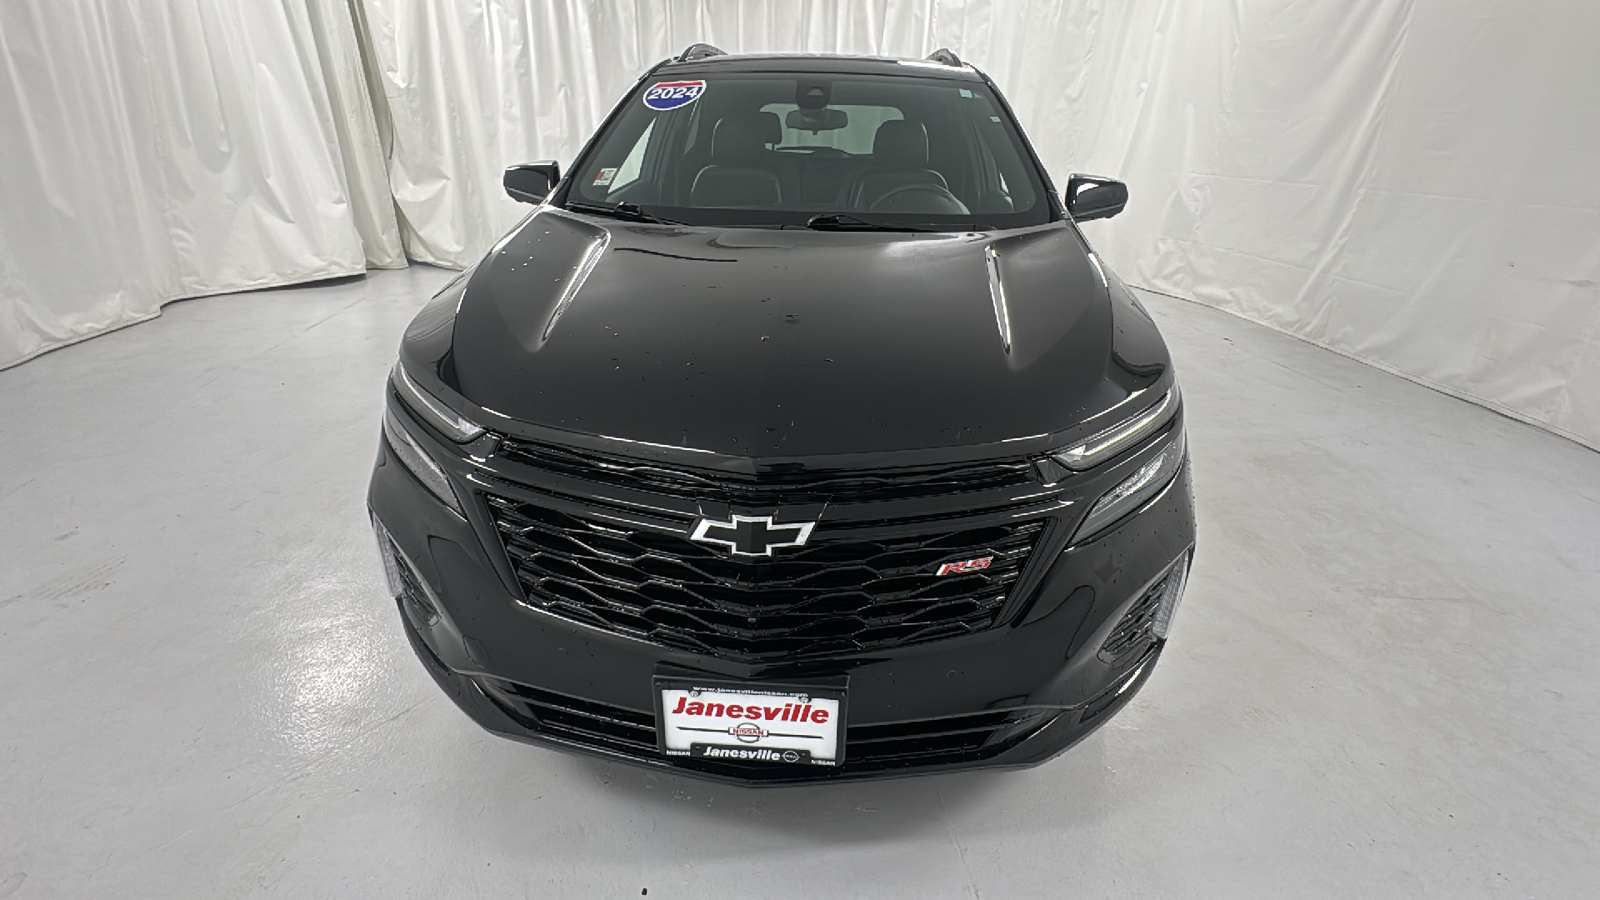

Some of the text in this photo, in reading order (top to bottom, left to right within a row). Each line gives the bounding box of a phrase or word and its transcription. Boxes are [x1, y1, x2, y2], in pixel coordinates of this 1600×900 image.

[647, 87, 699, 99] 2024
[935, 555, 994, 576] RS
[672, 697, 829, 723] Janesville
[703, 746, 781, 761] Janesville
